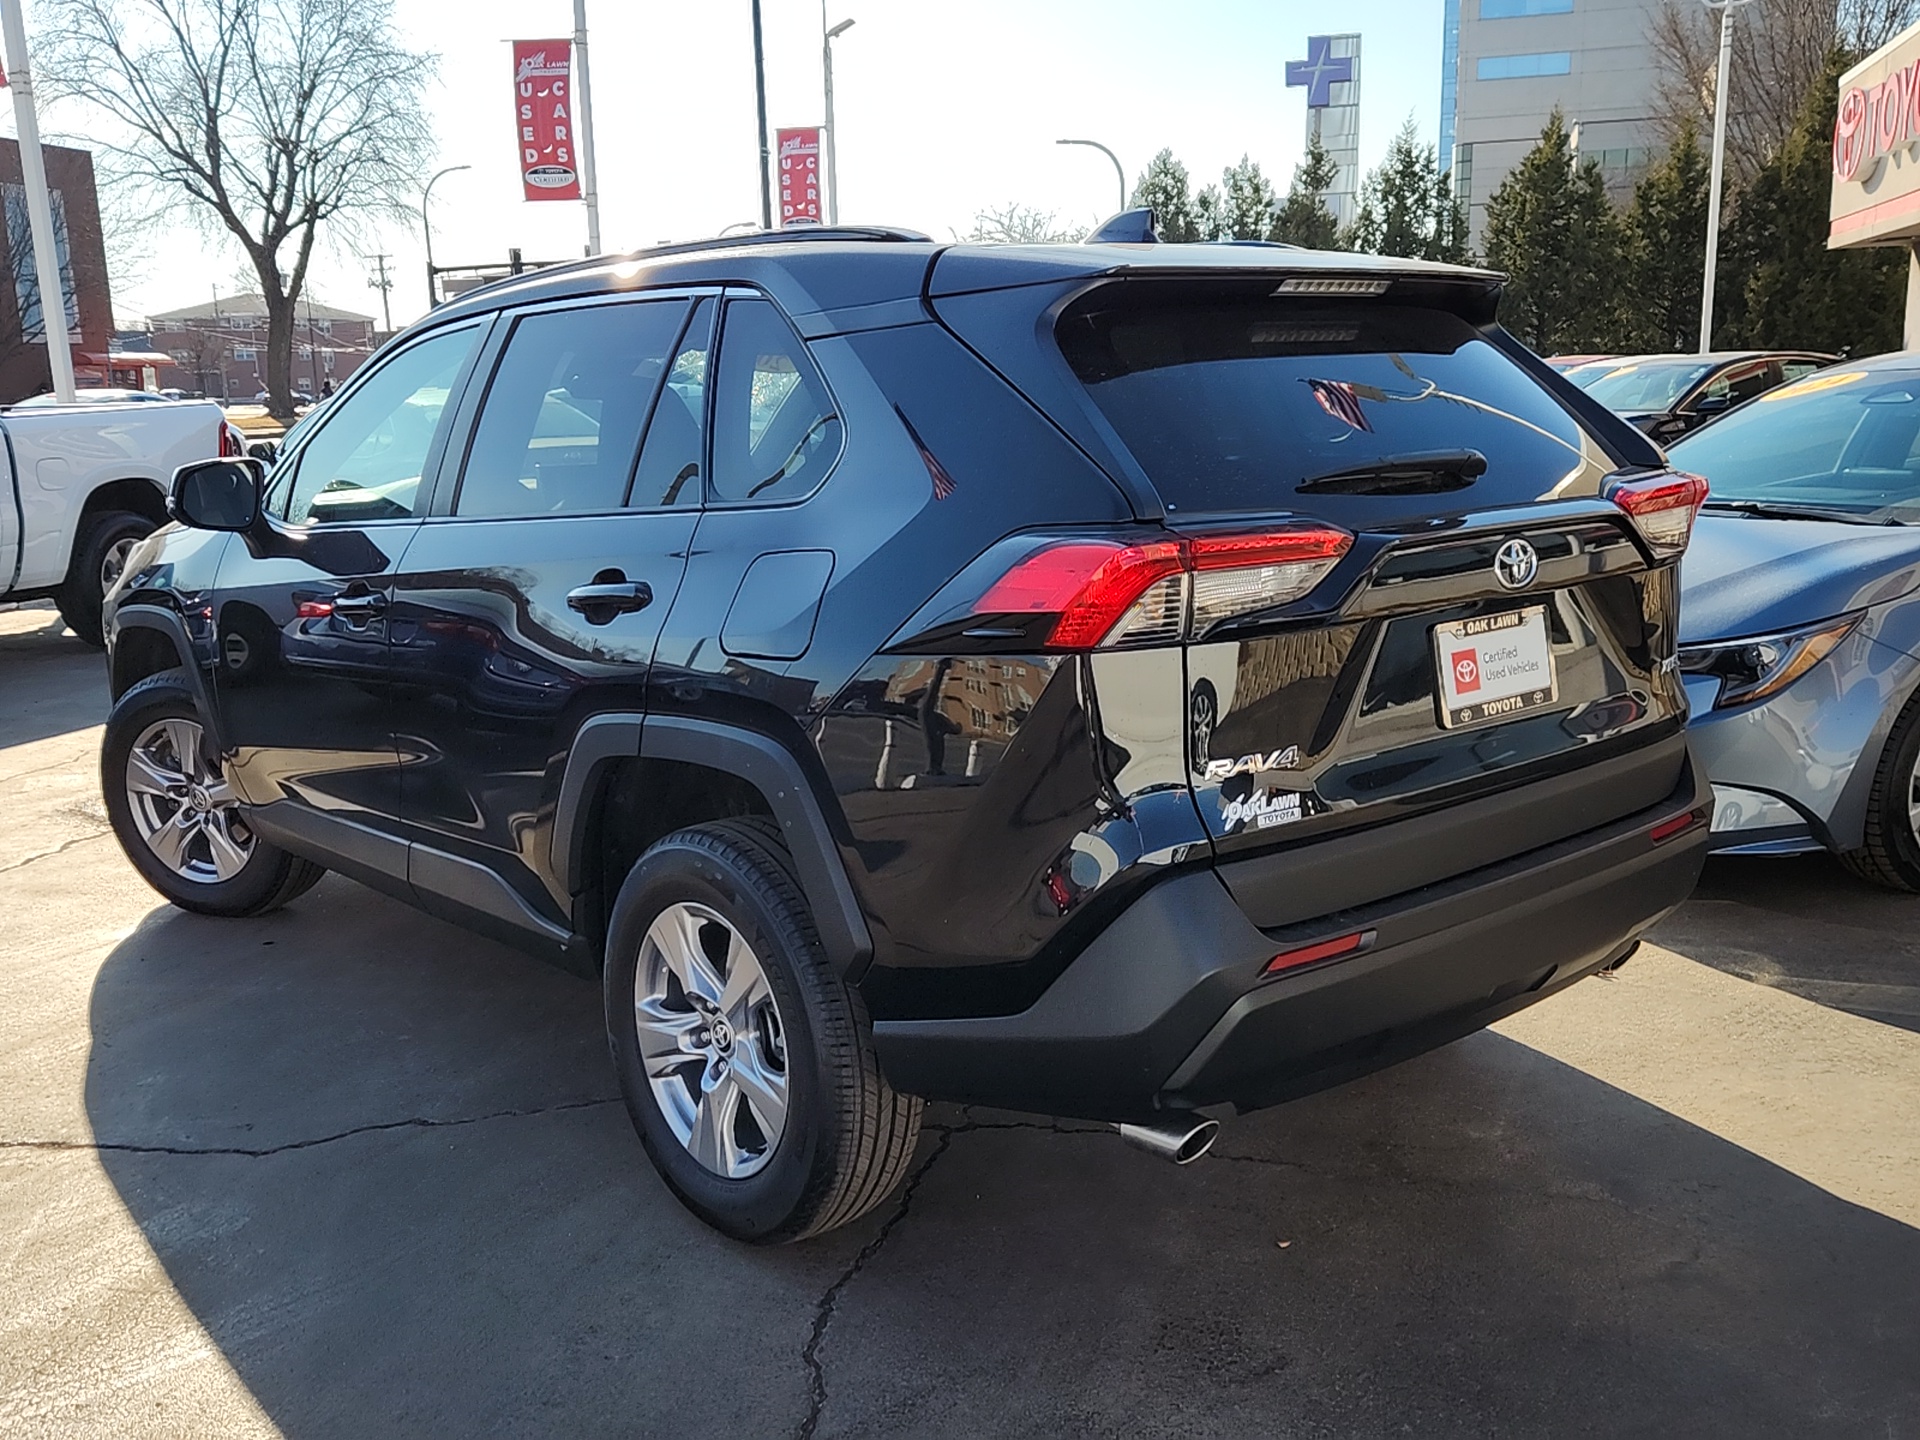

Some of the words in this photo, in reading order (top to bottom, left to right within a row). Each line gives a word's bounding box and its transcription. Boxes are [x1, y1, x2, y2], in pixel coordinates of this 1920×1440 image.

[520, 83, 538, 163] USED
[552, 81, 568, 162] CARS
[782, 159, 794, 216] USED
[806, 157, 817, 216] CARS
[1466, 618, 1488, 634] OAK
[1490, 613, 1519, 630] LAWN
[1482, 645, 1518, 664] Certified
[1485, 669, 1507, 681] Used
[1506, 660, 1540, 677] Vehicles
[1482, 696, 1523, 716] TOYOTA
[1204, 744, 1300, 781] RAV4
[1263, 810, 1297, 824] TOYOTA
